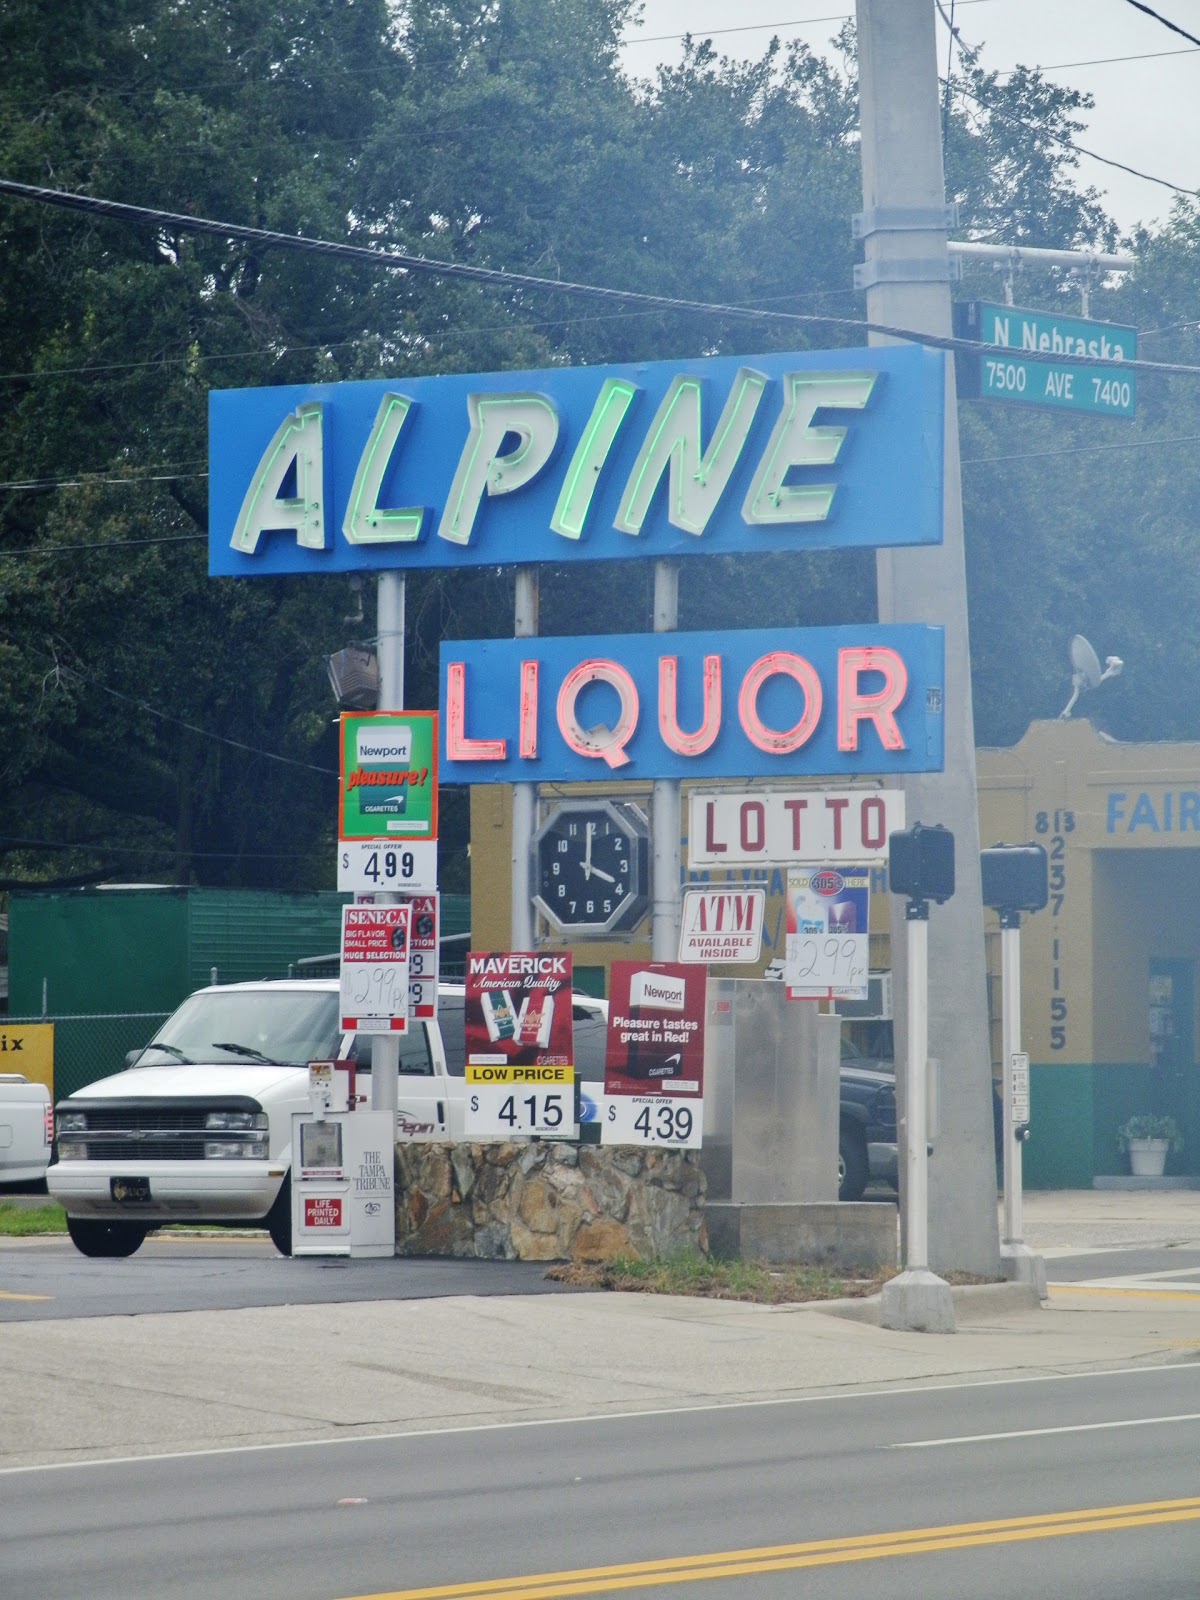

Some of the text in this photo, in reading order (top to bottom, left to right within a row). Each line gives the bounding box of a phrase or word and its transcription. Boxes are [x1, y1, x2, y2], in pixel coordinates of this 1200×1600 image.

[994, 316, 1124, 361] N Nebraska
[986, 361, 1130, 408] 7500 AVE 7400
[229, 366, 881, 555] ALPINE
[446, 646, 908, 768] LIQUOR
[360, 745, 406, 758] Newport
[347, 767, 428, 791] pleasure!
[364, 805, 398, 813] CIGARETTES
[1106, 790, 1200, 834] FAIR
[706, 797, 886, 852] LOTTO
[1035, 810, 1076, 834] 813
[558, 840, 568, 853] 10
[614, 838, 622, 851] 2
[364, 851, 414, 886] 4.99
[553, 863, 560, 875] 9
[620, 860, 628, 872] 3
[558, 884, 566, 897] 8
[615, 883, 623, 895] 4
[569, 901, 577, 913] 7
[586, 901, 594, 913] 6
[603, 900, 611, 913] 5
[349, 910, 407, 925] SENECA
[691, 895, 756, 932] ATM
[345, 930, 357, 938] BIG
[689, 937, 752, 948] AVAILABLE
[366, 952, 406, 960] SELECTION
[700, 948, 739, 958] INSIDE
[469, 957, 566, 974] MAVERICK
[473, 975, 561, 991] American Quality
[644, 984, 682, 1001] Newport
[613, 1016, 698, 1031] Pleasure tastes
[620, 1031, 689, 1043] great in Red!
[536, 1056, 568, 1066] CIGARETTES
[473, 1068, 565, 1081] LOW PRICE
[648, 1067, 674, 1077] CIGARETTES
[498, 1095, 563, 1129] 4.15
[634, 1106, 693, 1141] 4.39
[363, 1151, 380, 1164] THE
[359, 1165, 385, 1177] TAMPA
[353, 1177, 390, 1190] TRIBUNE
[315, 1200, 333, 1208] LIFE.
[307, 1208, 339, 1217] PRINTED
[314, 1216, 336, 1226] DAILY.
